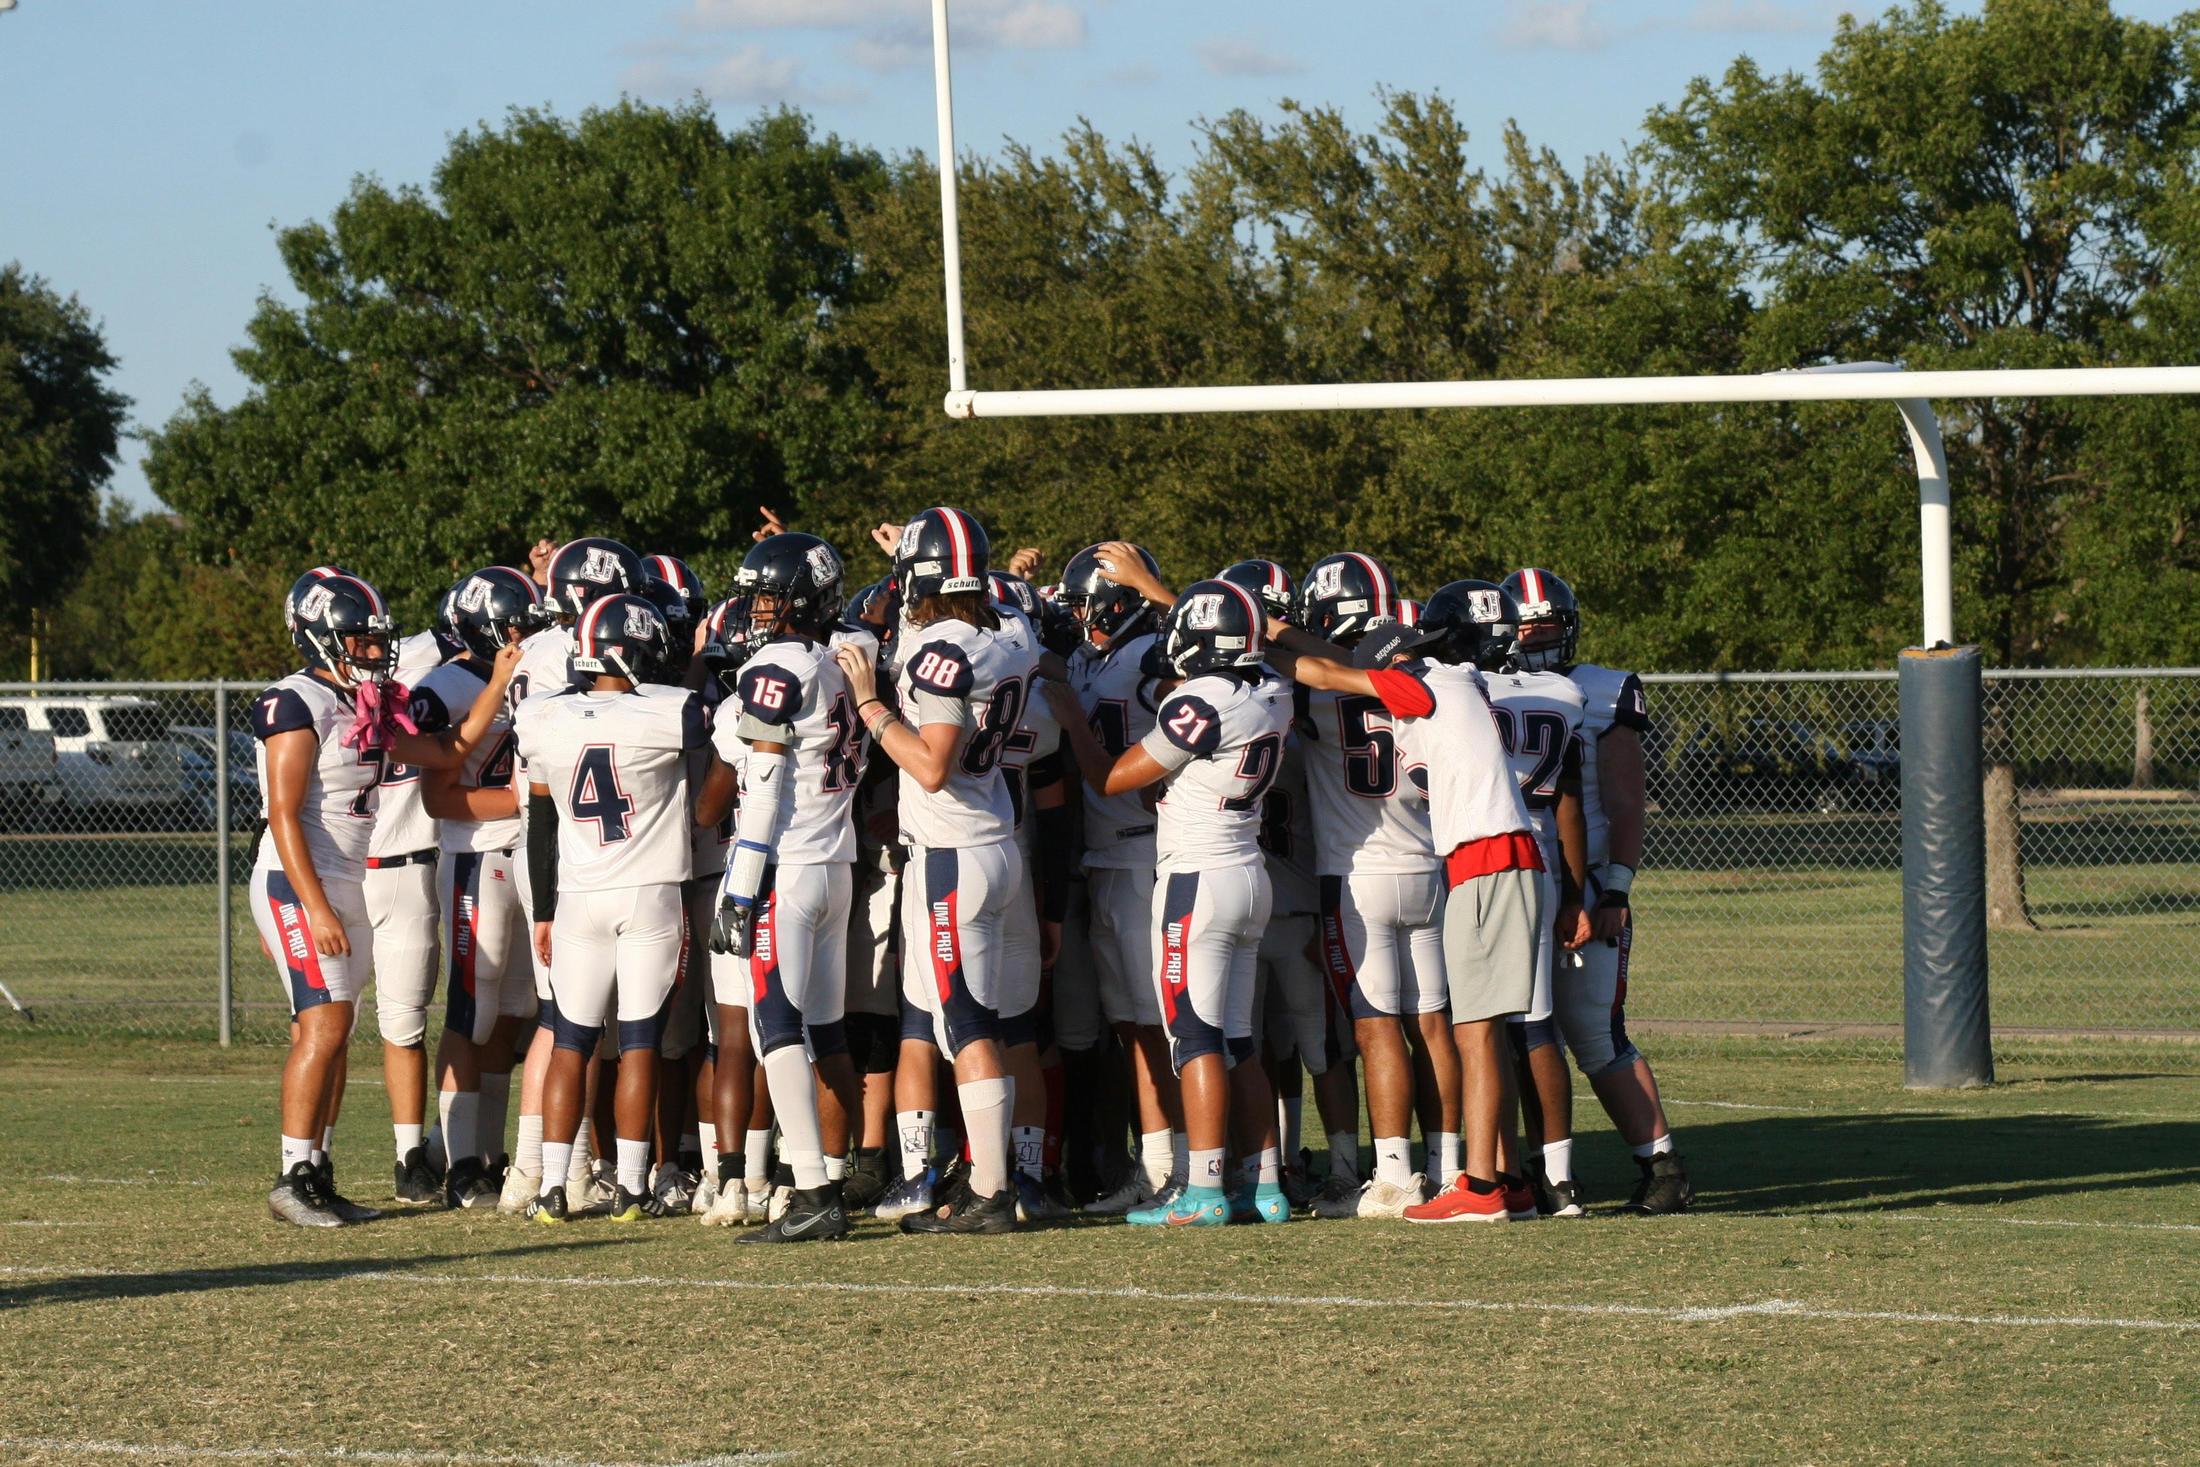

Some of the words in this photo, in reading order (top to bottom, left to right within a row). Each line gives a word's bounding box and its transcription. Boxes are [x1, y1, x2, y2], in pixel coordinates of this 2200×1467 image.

[947, 580, 979, 589] schutt
[915, 651, 960, 689] 88
[751, 676, 787, 711] 15
[262, 696, 280, 727] 7
[1167, 703, 1209, 746] 21
[567, 743, 636, 848] 4
[933, 902, 950, 928] UME
[286, 928, 309, 959] PREP
[756, 928, 771, 961] PREP
[936, 931, 954, 962] PREP
[1167, 922, 1183, 949] UME
[1165, 952, 1182, 984] PREP
